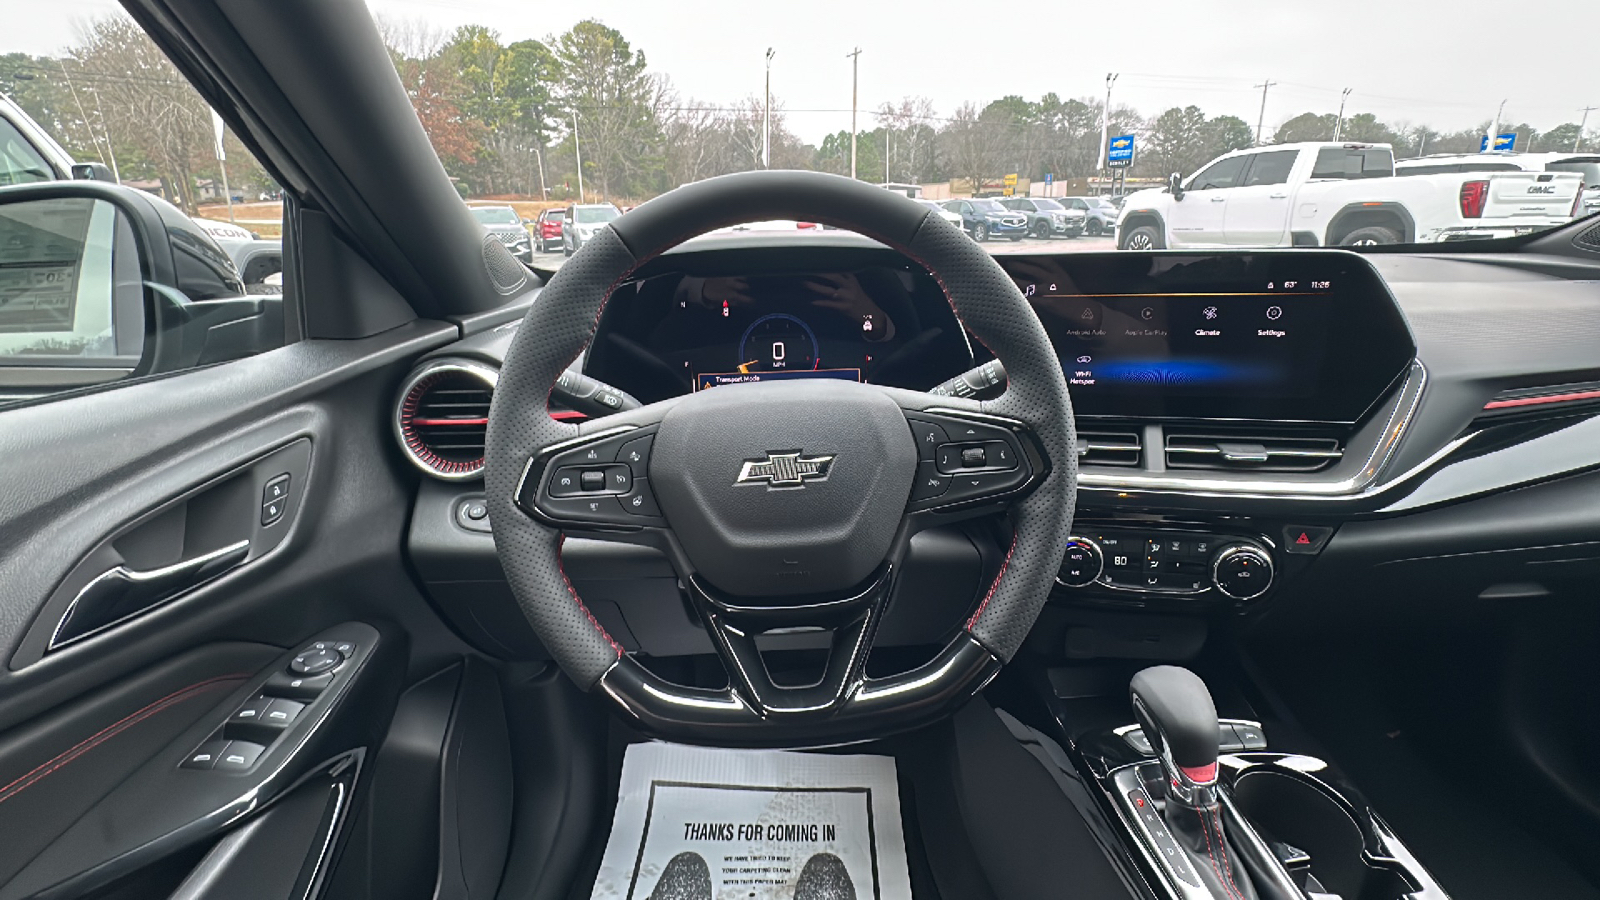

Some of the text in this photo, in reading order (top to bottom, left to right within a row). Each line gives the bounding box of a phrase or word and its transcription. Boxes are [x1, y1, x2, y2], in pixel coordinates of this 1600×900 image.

[1527, 186, 1556, 194] GMC
[1257, 329, 1286, 337] Settings
[772, 342, 785, 360] 0
[715, 374, 760, 384] Transport Mode
[1070, 378, 1096, 386] Hotspot
[684, 822, 836, 842] THANKS FOR COMING IN
